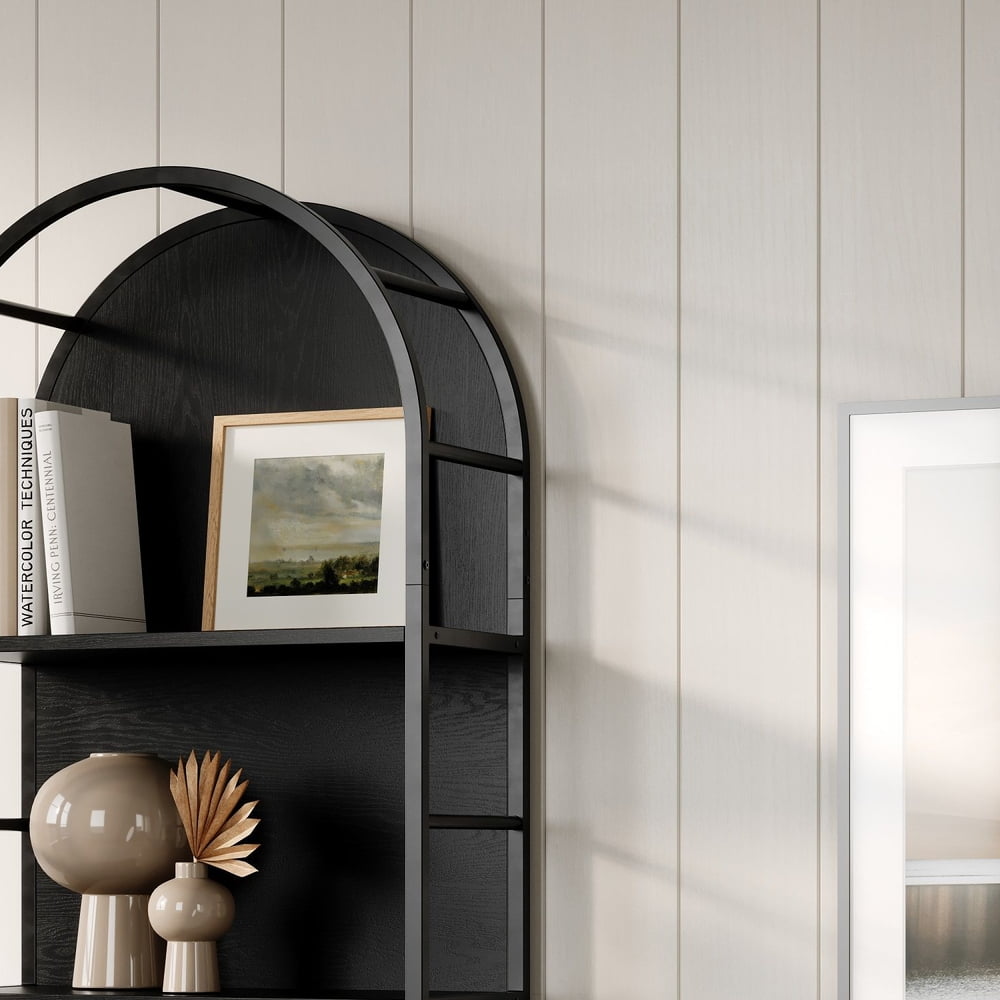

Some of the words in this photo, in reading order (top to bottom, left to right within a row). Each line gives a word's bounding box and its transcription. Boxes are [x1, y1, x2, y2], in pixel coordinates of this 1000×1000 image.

[21, 407, 33, 511] TECHNIQUES
[42, 450, 57, 522] CENTENNIAL
[21, 519, 33, 628] WATERCOLOR
[48, 524, 60, 558] PENN:
[50, 561, 63, 605] IRVING
